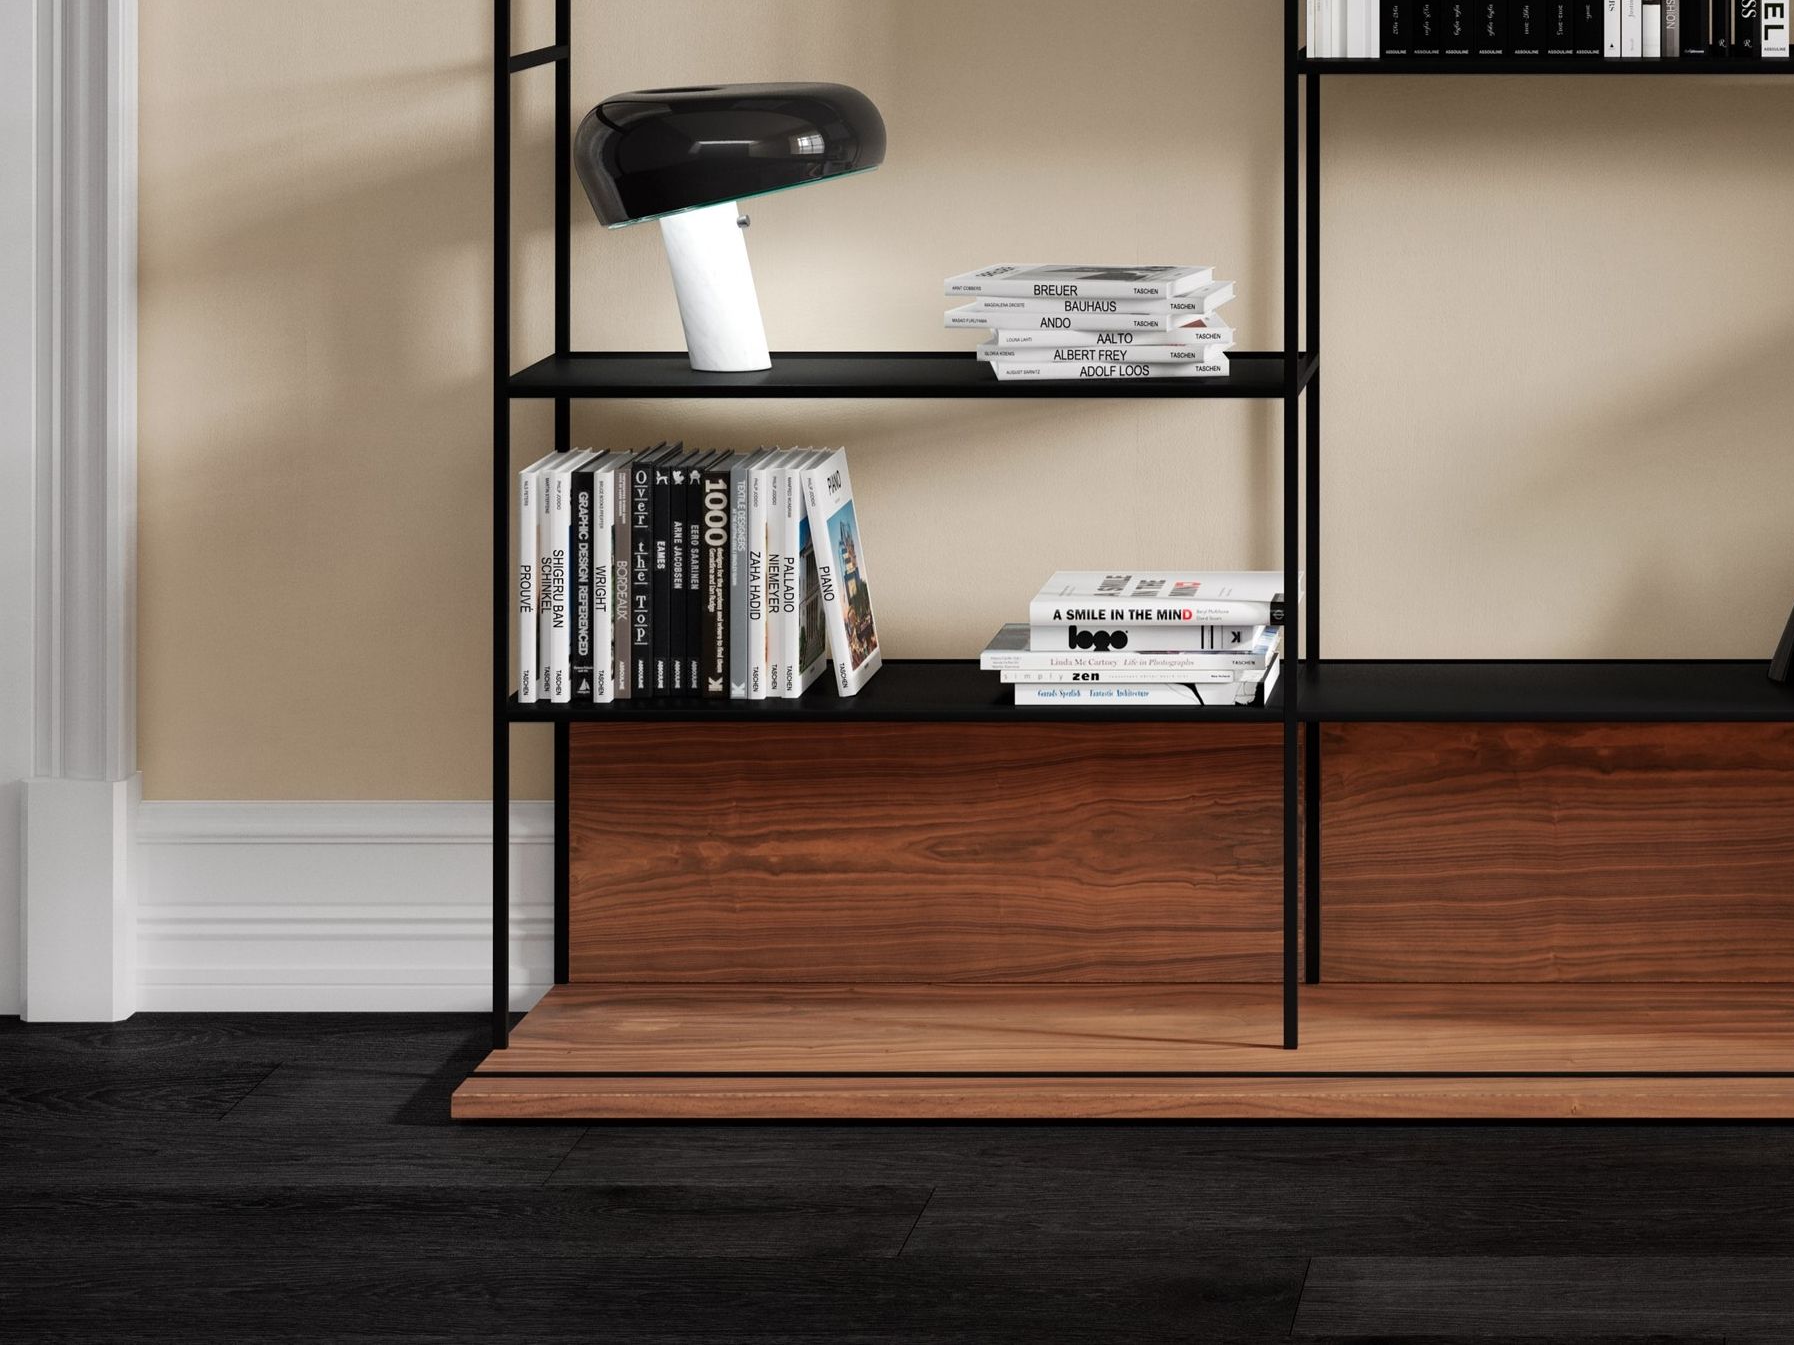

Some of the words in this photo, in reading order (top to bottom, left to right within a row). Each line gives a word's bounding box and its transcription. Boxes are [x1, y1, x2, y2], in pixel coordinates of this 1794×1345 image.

[1033, 284, 1078, 296] BREUER
[1064, 300, 1117, 312] BAUHAUS
[1040, 317, 1071, 328] ANDO
[1096, 332, 1133, 344] AALTO
[1053, 349, 1095, 361] ALBERT
[1098, 349, 1127, 361] FREY
[1079, 365, 1116, 377] ADOLF
[1119, 365, 1149, 377] LOOS
[578, 492, 589, 539] GRAPHIC
[704, 478, 727, 546] 1000
[674, 521, 682, 544] ARNE
[690, 524, 699, 546] EERO
[578, 542, 589, 582] DESIGN
[657, 541, 666, 569] EAMES
[674, 545, 682, 589] JACOBSEN
[690, 548, 699, 590] SAARINEN
[750, 551, 760, 582] ZAHA
[520, 565, 533, 613] PROUVÉ
[541, 557, 552, 614] SCHINKEL
[552, 549, 564, 602] SHIGERU
[595, 565, 606, 612] WRIGHT
[616, 560, 627, 620] BORDEAUX
[768, 554, 779, 613] NIEMEYER
[783, 557, 795, 613] PALLADIO
[819, 565, 835, 601] PIANO
[552, 604, 564, 628] BAN
[750, 584, 760, 620] HADID
[1053, 609, 1062, 620] A
[1066, 609, 1107, 620] SMILE
[1111, 609, 1124, 620] IN
[1128, 609, 1152, 620] THE
[1156, 609, 1193, 620] MIND
[578, 585, 589, 656] REFERENCED
[1072, 672, 1100, 681] zen
